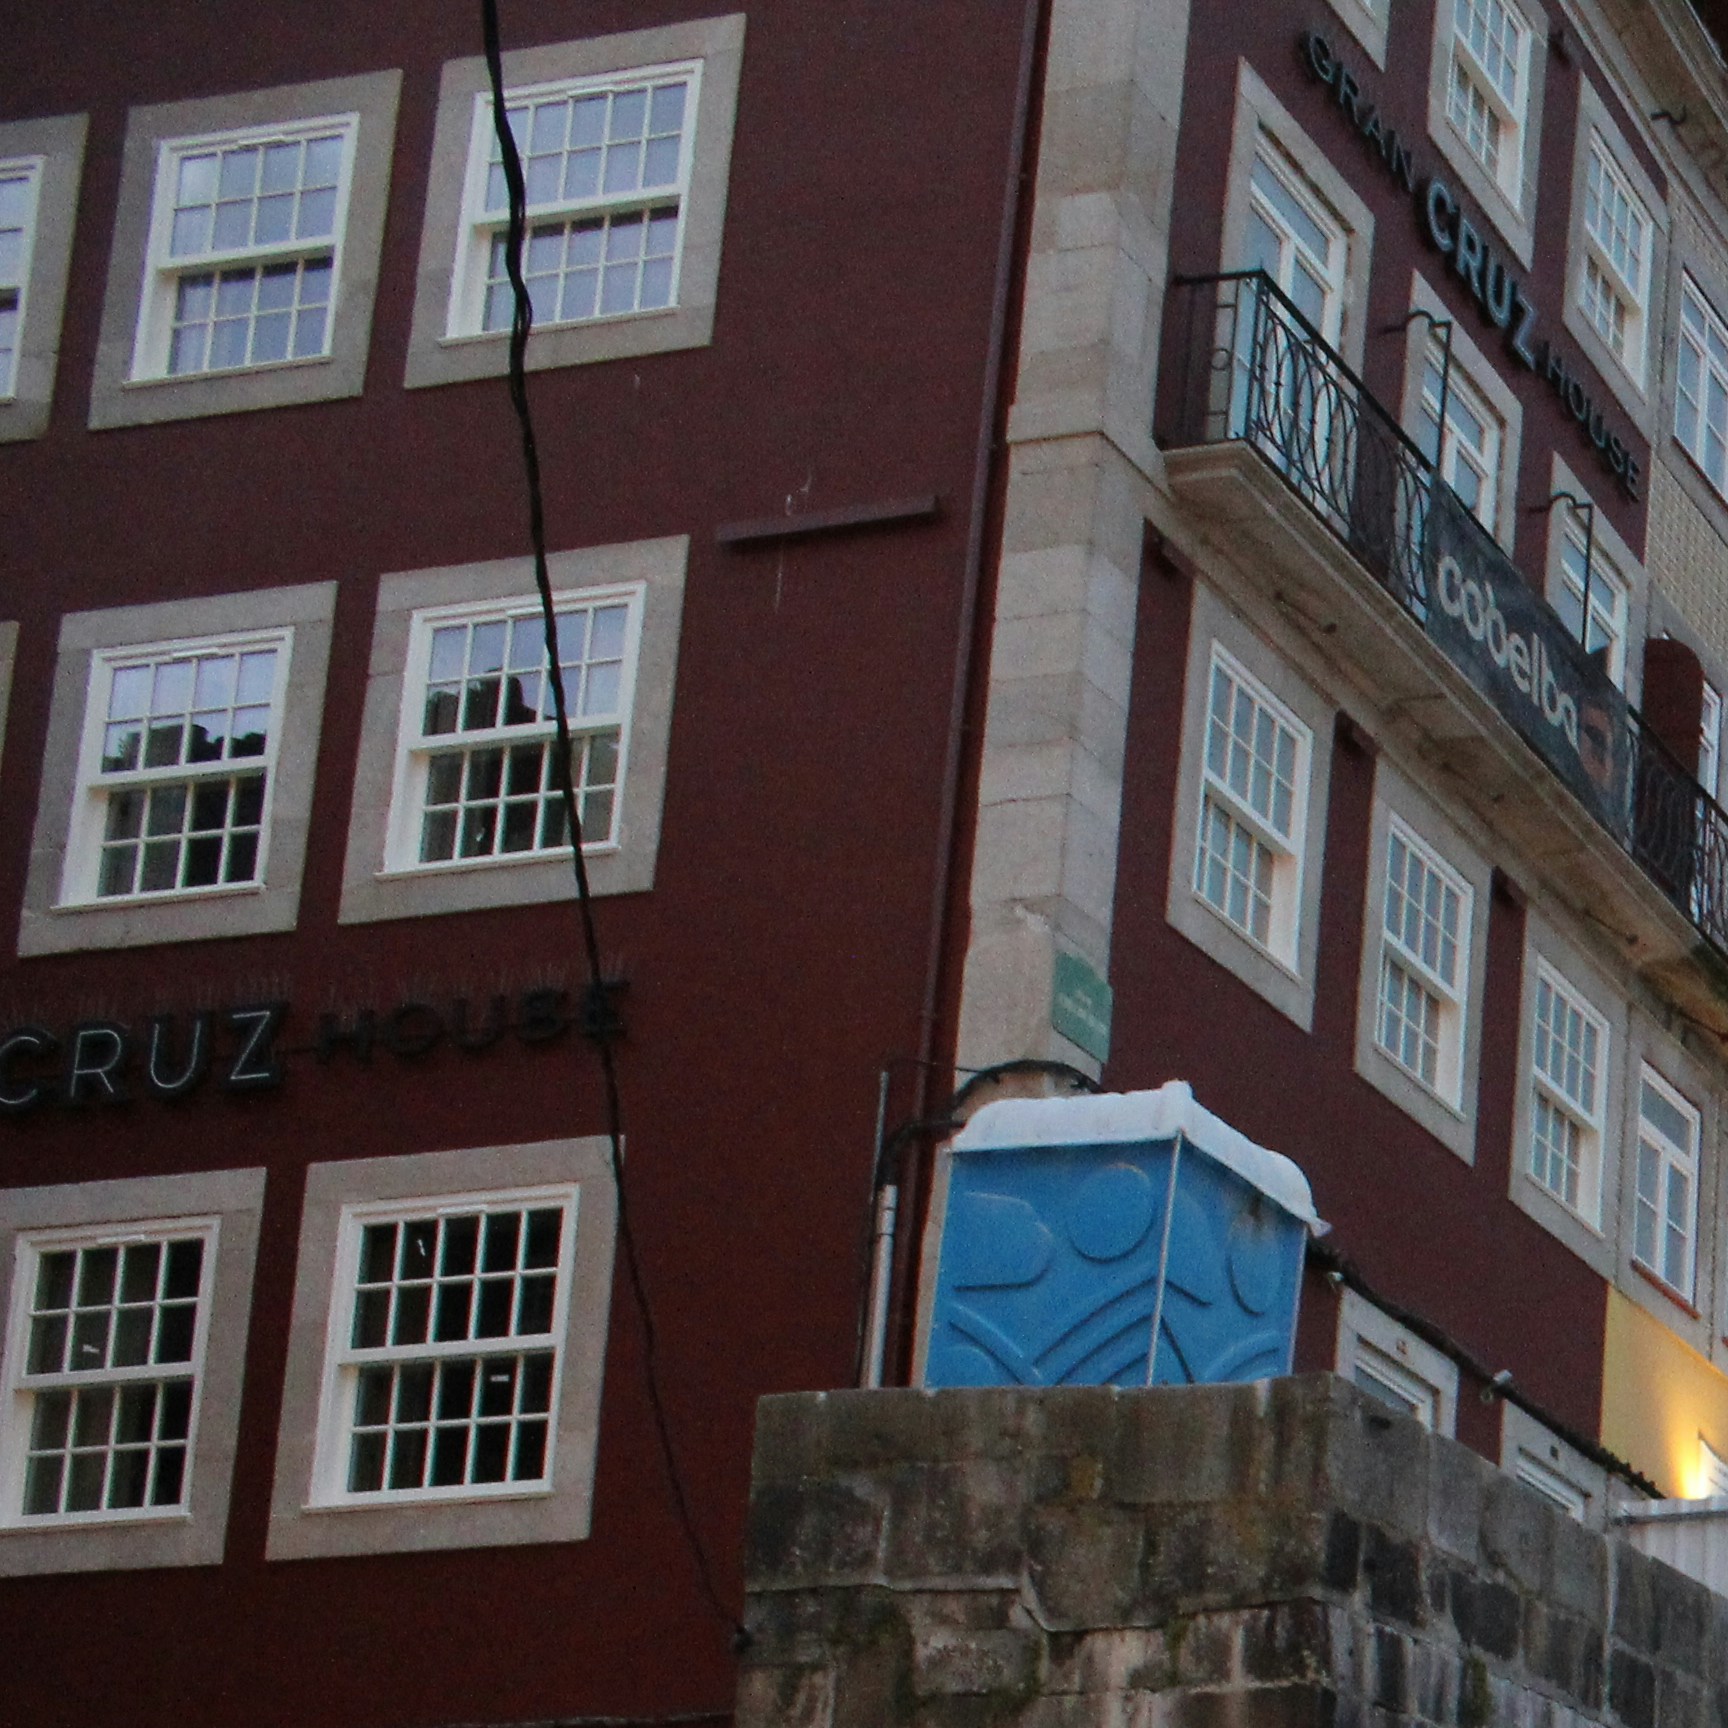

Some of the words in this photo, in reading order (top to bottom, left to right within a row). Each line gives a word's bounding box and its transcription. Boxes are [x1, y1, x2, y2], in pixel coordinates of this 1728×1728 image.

[1421, 179, 1541, 371] CRUZ
[1544, 350, 1640, 502] HOUSE
[1438, 556, 1580, 756] cobelba
[0, 1006, 286, 1114] CRUZ
[314, 978, 634, 1066] HOUSE
